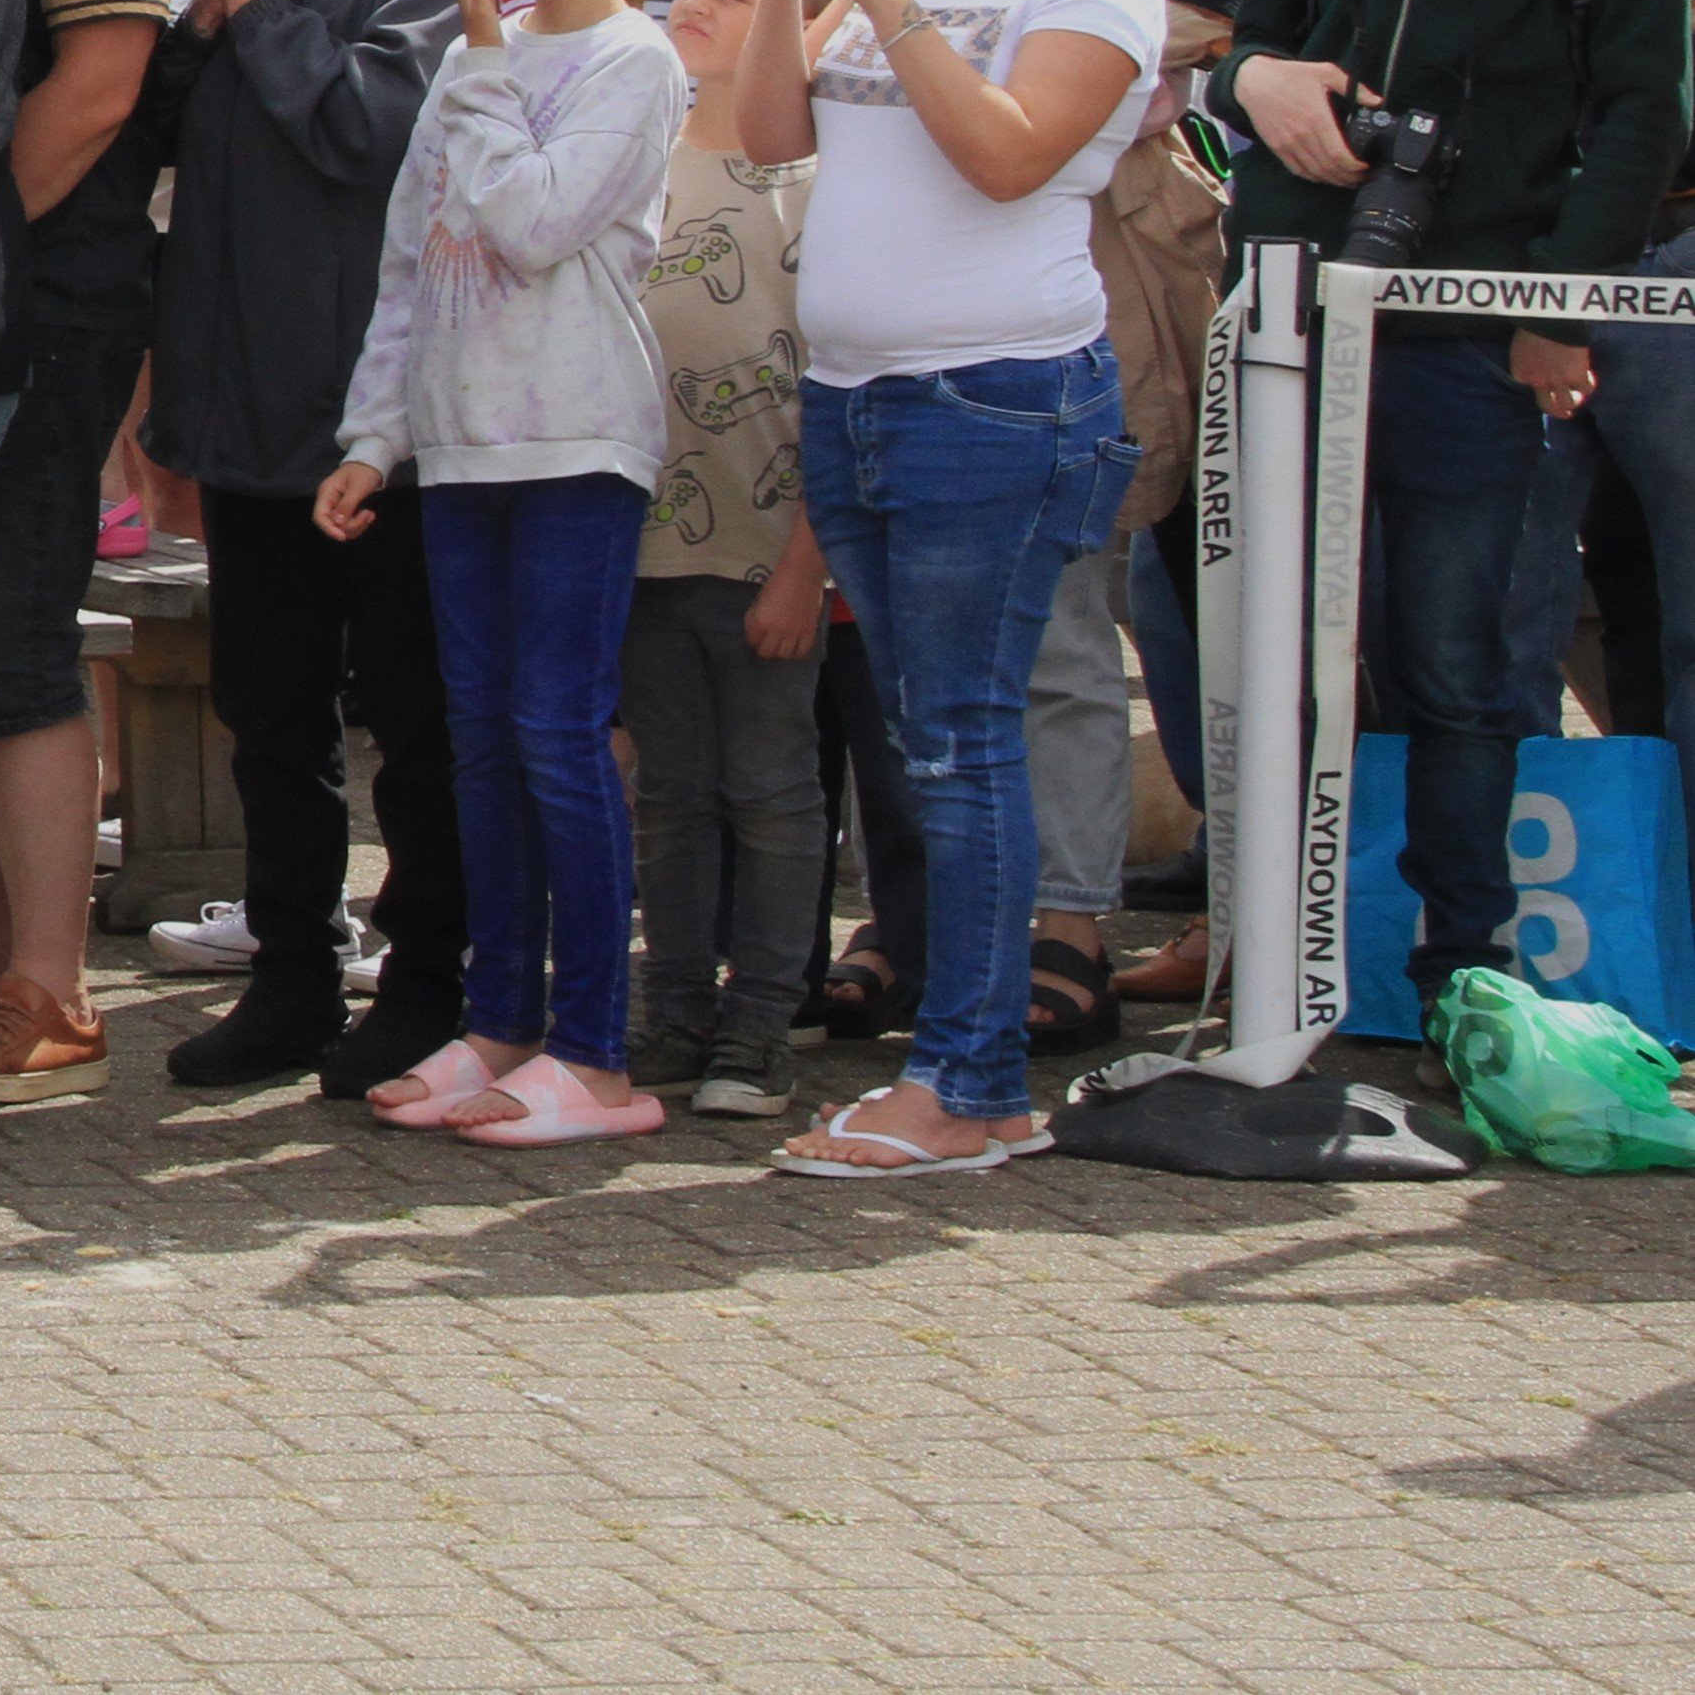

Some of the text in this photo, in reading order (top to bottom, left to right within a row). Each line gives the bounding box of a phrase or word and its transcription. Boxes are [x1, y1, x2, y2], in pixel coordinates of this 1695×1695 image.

[1373, 274, 1695, 318] AYDOWN AREA
[1201, 467, 1233, 568] AREA
[1304, 770, 1342, 1028] LAYDOWN AR
